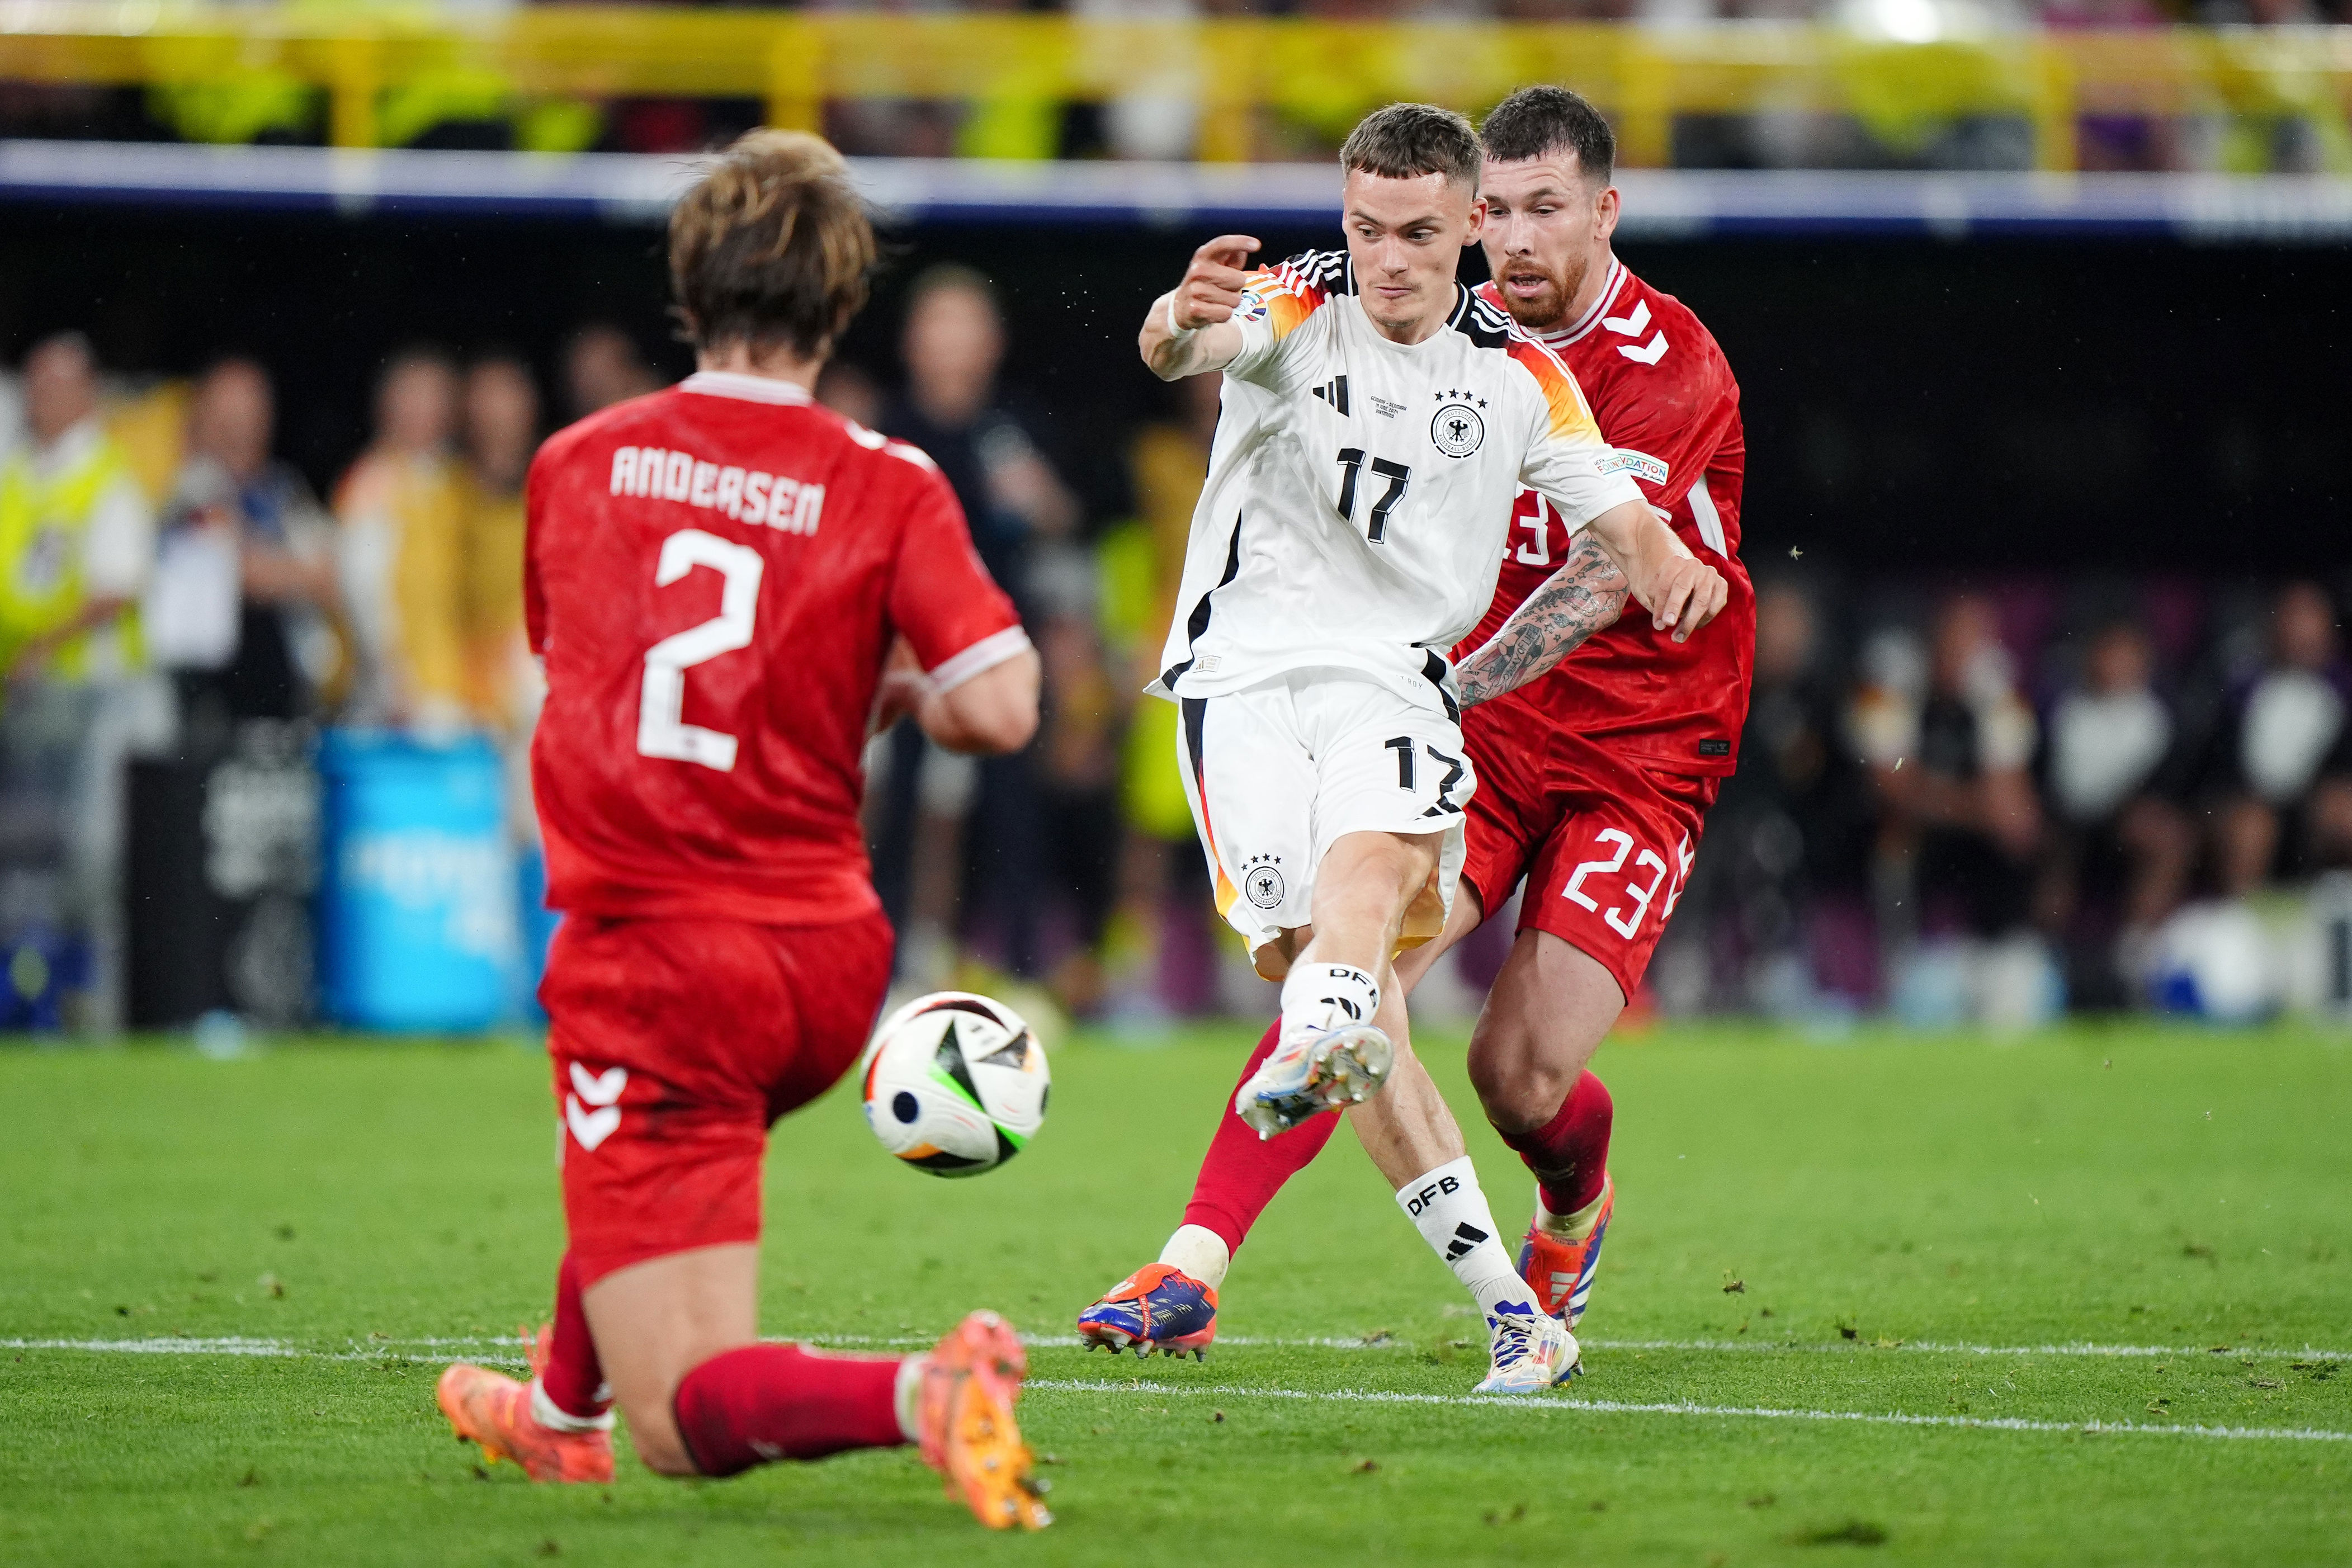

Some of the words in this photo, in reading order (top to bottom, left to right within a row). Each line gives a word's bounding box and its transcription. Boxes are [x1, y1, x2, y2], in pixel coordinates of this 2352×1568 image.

[1443, 410, 1474, 423] DEUTSCHER
[1438, 434, 1475, 451] FUSSBALL-BUND
[610, 446, 826, 537] ANDERSEN
[1336, 448, 1411, 544] 17
[637, 528, 764, 773] 2
[1385, 736, 1468, 798] 17
[1253, 871, 1276, 881] DEUTSCHER
[1562, 828, 1667, 939] 23
[1330, 969, 1378, 1008] DFB
[1408, 1177, 1460, 1217] DFB
